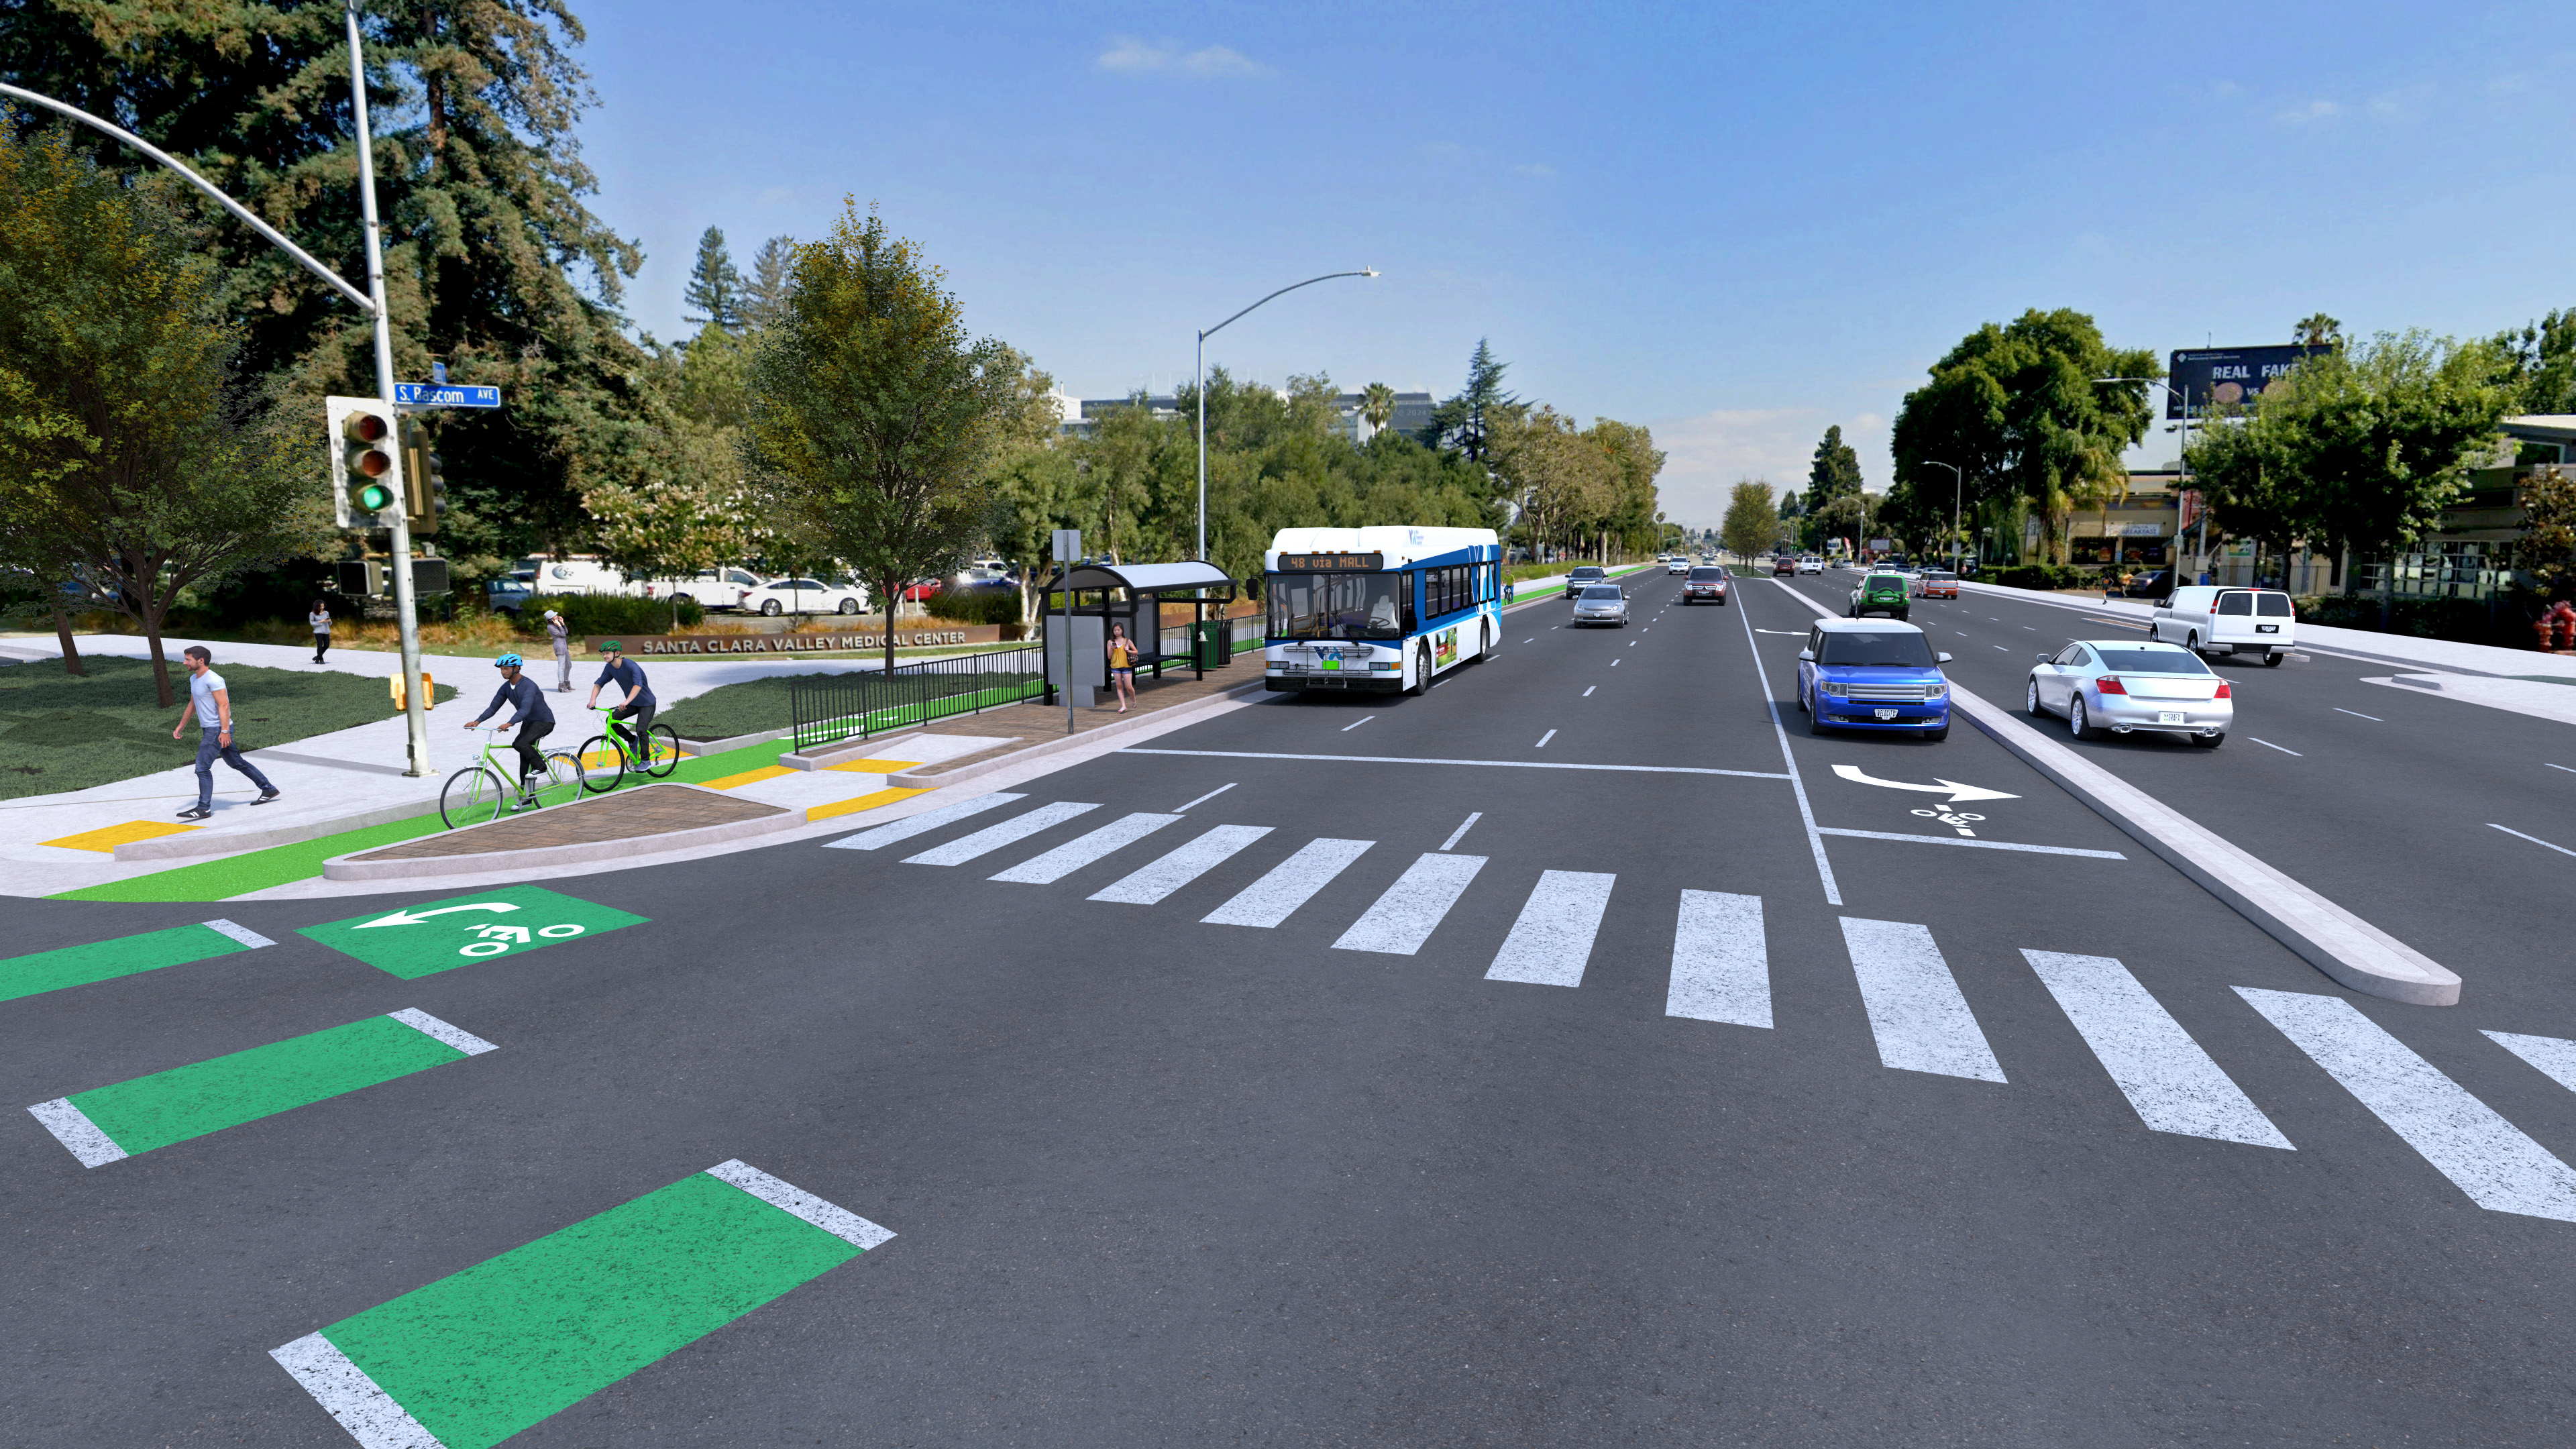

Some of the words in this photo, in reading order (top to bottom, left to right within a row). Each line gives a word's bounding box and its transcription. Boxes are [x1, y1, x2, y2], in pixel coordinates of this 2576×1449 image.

[2212, 366, 2250, 379] REAL
[2261, 364, 2300, 378] FAKE
[399, 386, 411, 401] S.
[413, 386, 464, 403] Bascom
[477, 389, 494, 400] AVE
[1291, 557, 1305, 568] 48
[1312, 556, 1332, 568] via
[1340, 556, 1369, 568] MALL
[643, 640, 702, 653] SANTA
[707, 639, 767, 652] CLARA
[772, 637, 836, 651] VALLEY
[841, 634, 909, 649] MEDICAL
[914, 631, 966, 645] CENTER
